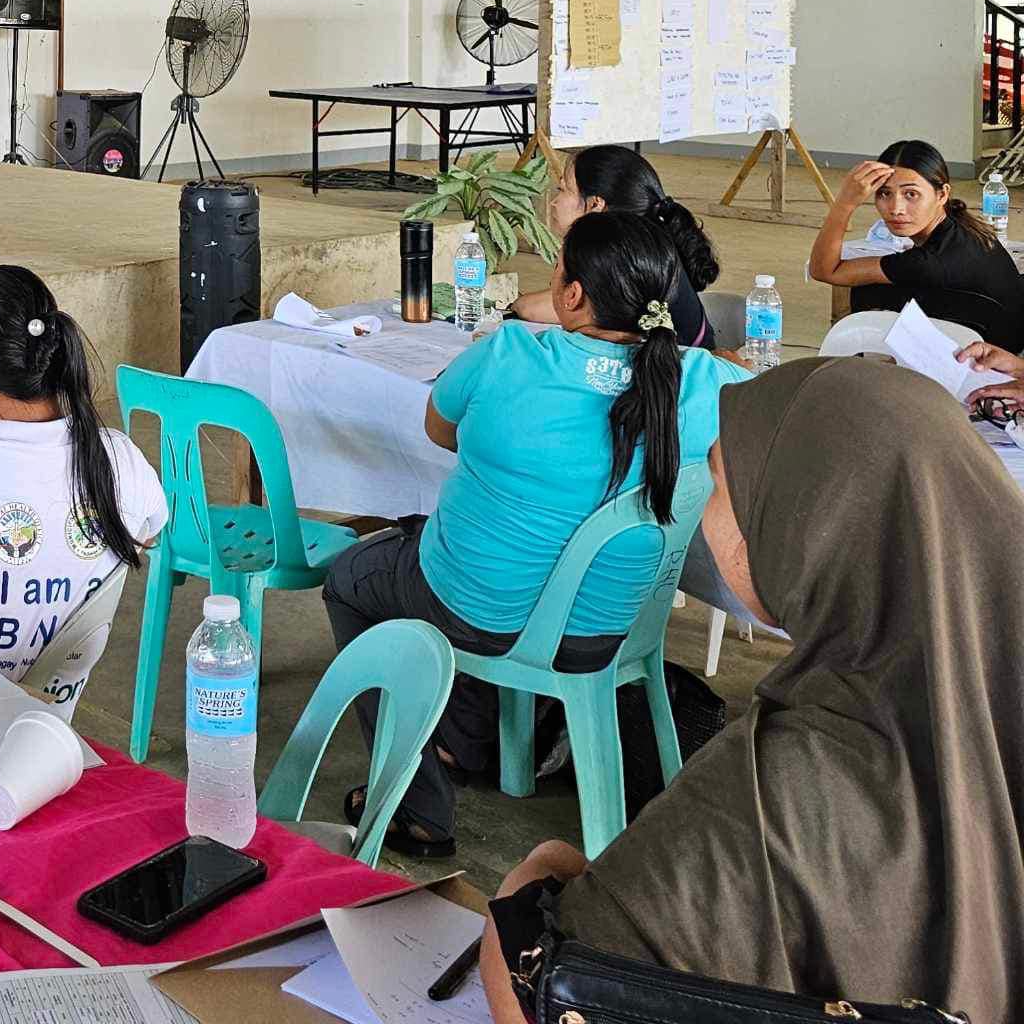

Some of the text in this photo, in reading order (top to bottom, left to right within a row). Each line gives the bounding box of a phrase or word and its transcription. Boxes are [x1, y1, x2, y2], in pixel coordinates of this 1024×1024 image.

[0, 570, 9, 605] I
[23, 576, 71, 605] am
[193, 687, 246, 700] NATURE'S
[199, 697, 241, 708] SPRING
